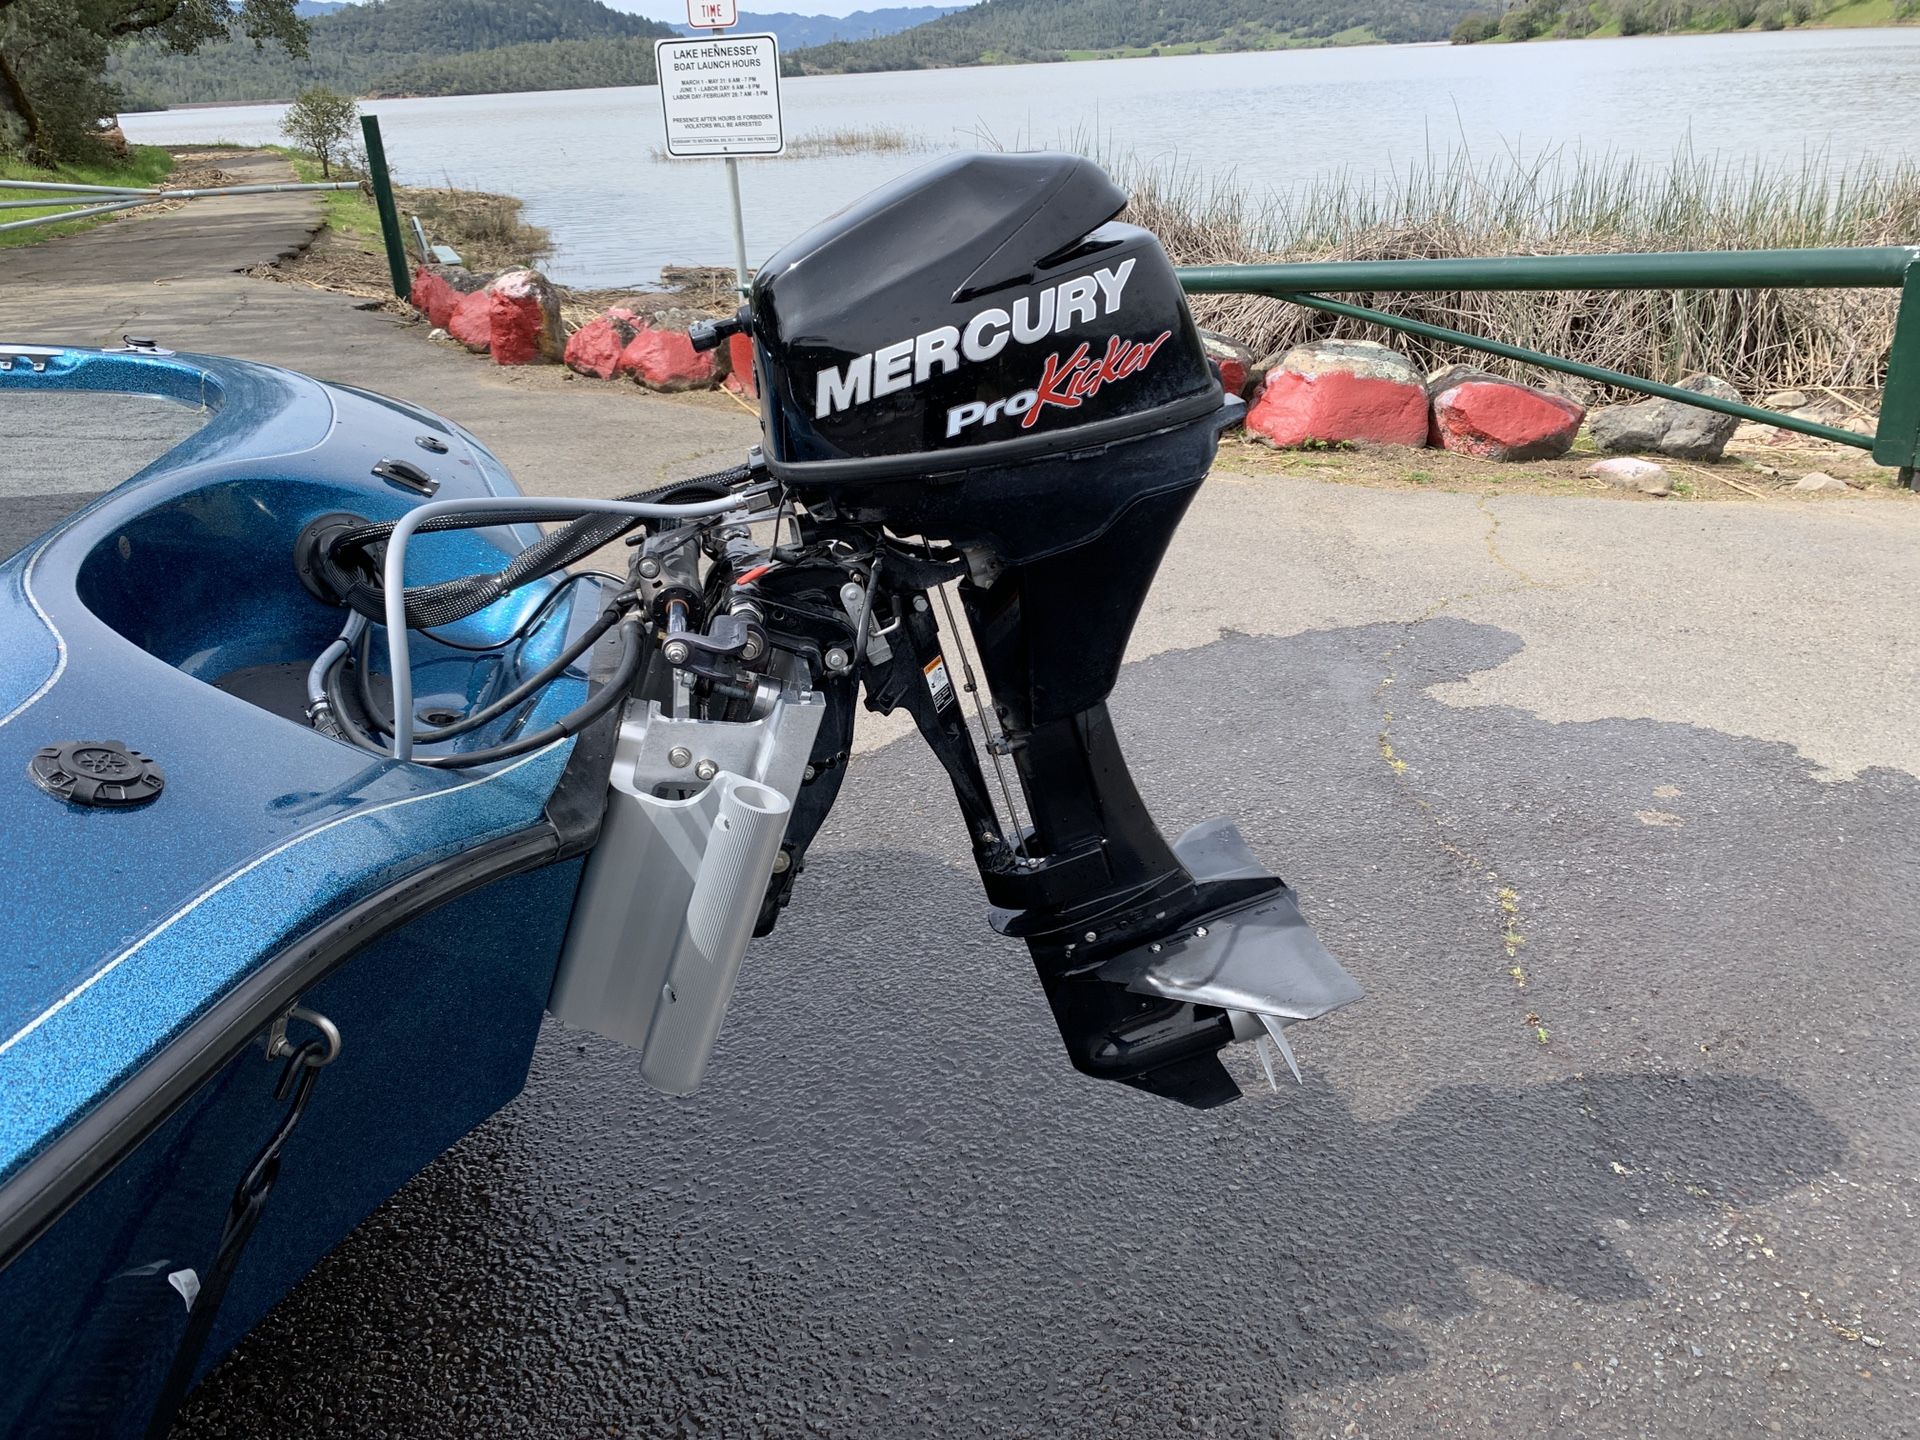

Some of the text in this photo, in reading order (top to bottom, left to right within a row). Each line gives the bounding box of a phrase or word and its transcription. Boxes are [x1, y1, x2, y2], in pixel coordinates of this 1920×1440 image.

[701, 4, 722, 17] TIME
[673, 45, 758, 60] LAKE HENNESSEY
[674, 58, 761, 71] BOAT LAUNCH HOURS
[816, 258, 1137, 420] MERCURY
